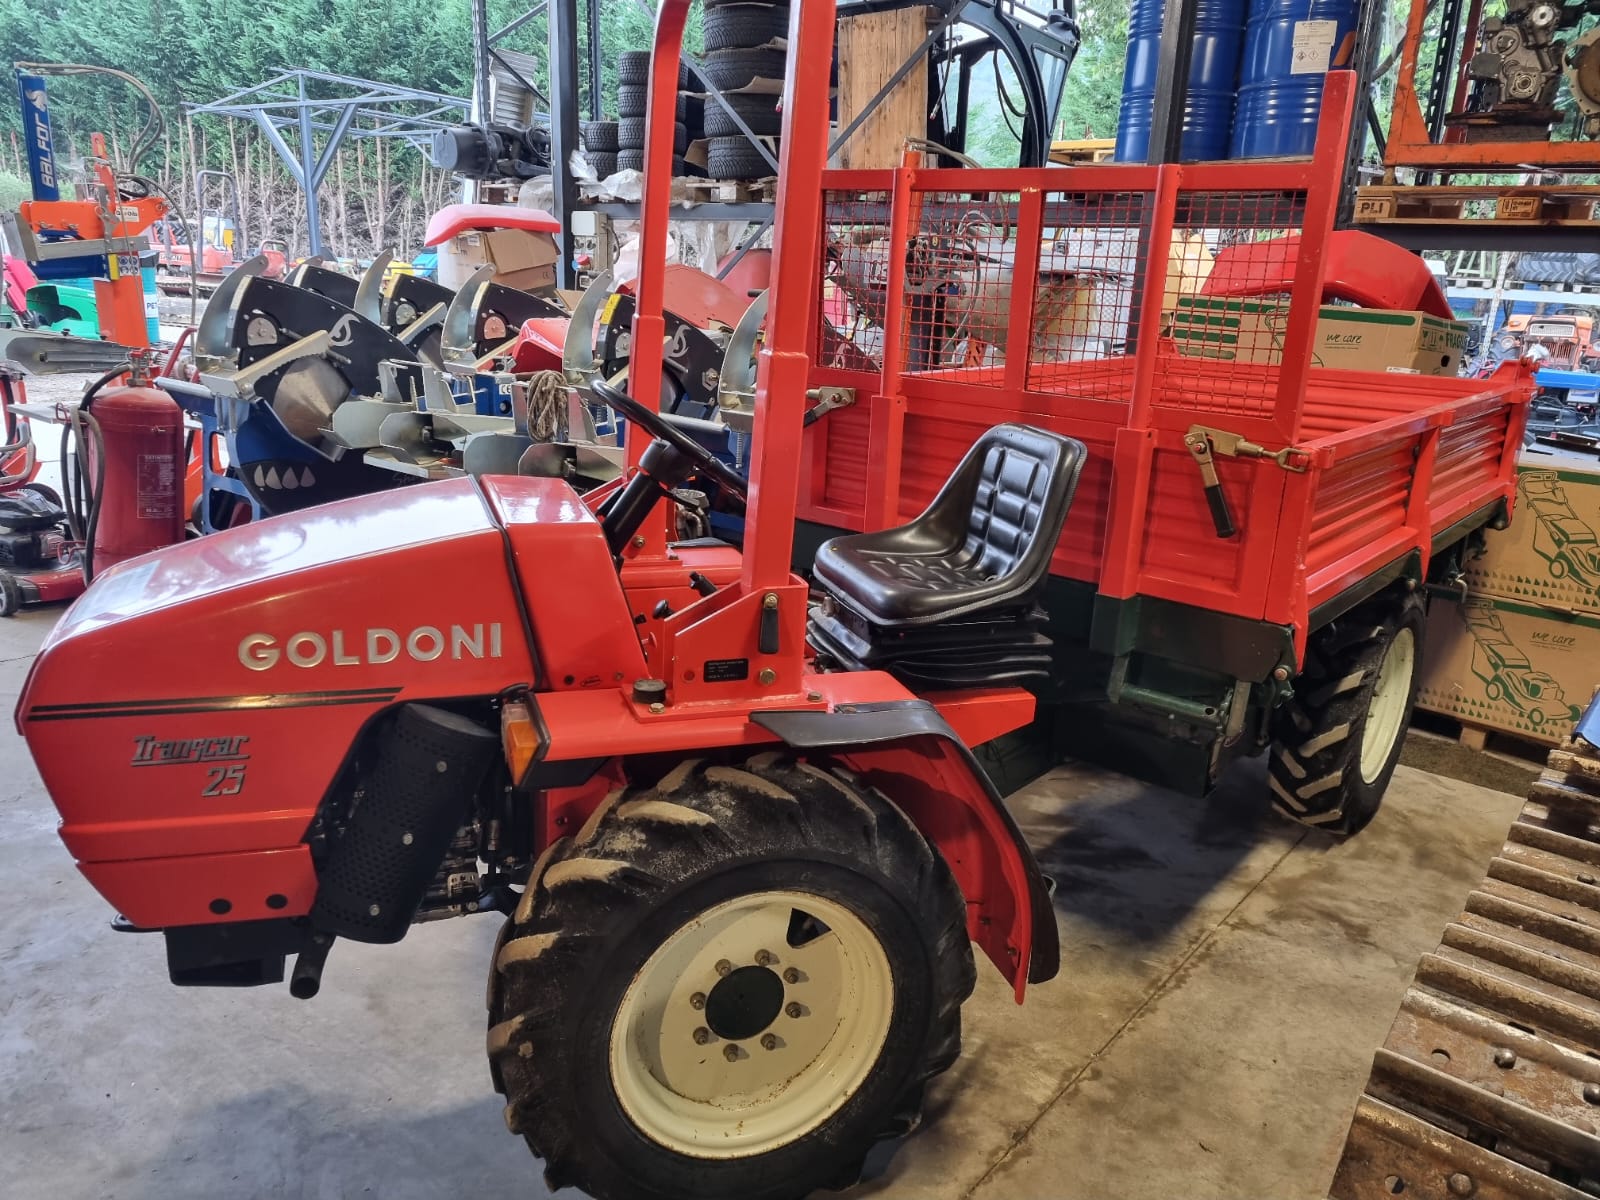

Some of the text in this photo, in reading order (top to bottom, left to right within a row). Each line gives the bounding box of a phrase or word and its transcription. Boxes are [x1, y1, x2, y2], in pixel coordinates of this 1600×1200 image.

[1326, 333, 1362, 344] we care
[237, 622, 502, 672] GOLDONI
[1532, 631, 1577, 647] we care
[130, 735, 251, 767] Transcar
[201, 764, 247, 798] 25
